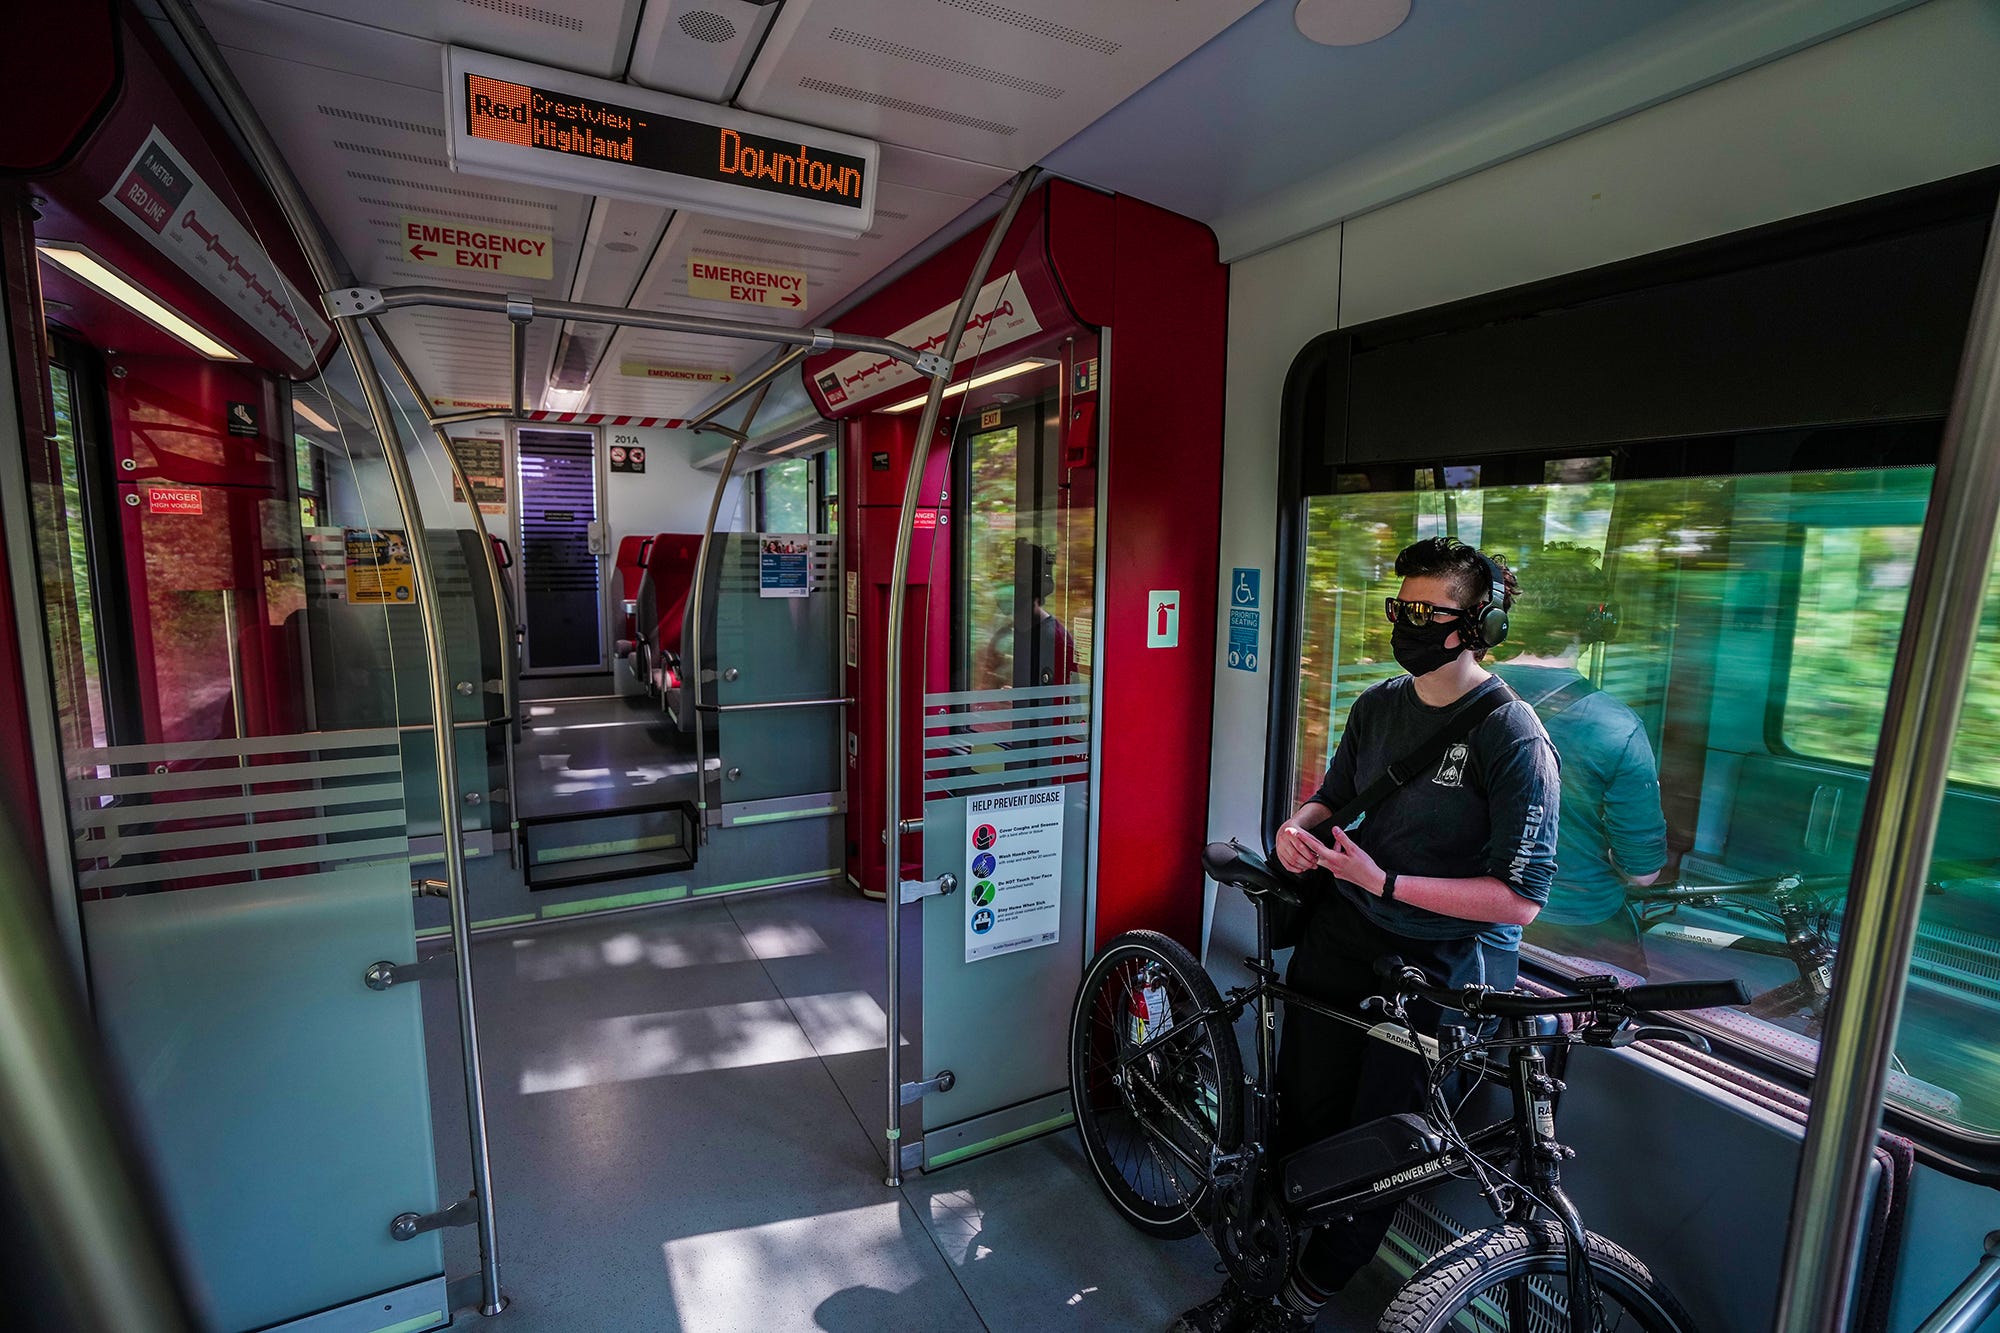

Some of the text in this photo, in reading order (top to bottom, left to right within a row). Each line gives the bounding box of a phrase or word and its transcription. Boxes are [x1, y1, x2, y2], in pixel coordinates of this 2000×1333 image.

[475, 93, 528, 125] Red
[532, 94, 632, 131] Crestview
[533, 118, 634, 162] Highland
[150, 161, 175, 187] METRO
[719, 128, 861, 198] Downtown
[127, 183, 167, 222] RED LINE
[407, 223, 546, 257] EMERGENCY
[456, 250, 502, 270] EXIT
[692, 263, 802, 291] EMERGENCY
[730, 285, 767, 303] EXIT
[647, 369, 695, 380] EMERGENCY
[453, 401, 494, 409] EMERGENCY
[984, 411, 998, 426] EXIT
[615, 434, 639, 445] 201A
[152, 492, 198, 502] DANGER
[1230, 611, 1259, 620] PRIORITY
[1231, 618, 1257, 627] SEATING
[972, 791, 1060, 812] HELP PREVENT DISEASE
[1385, 1033, 1432, 1056] RADMISSN
[1373, 1177, 1391, 1193] RAD
[1391, 1165, 1425, 1186] POWER
